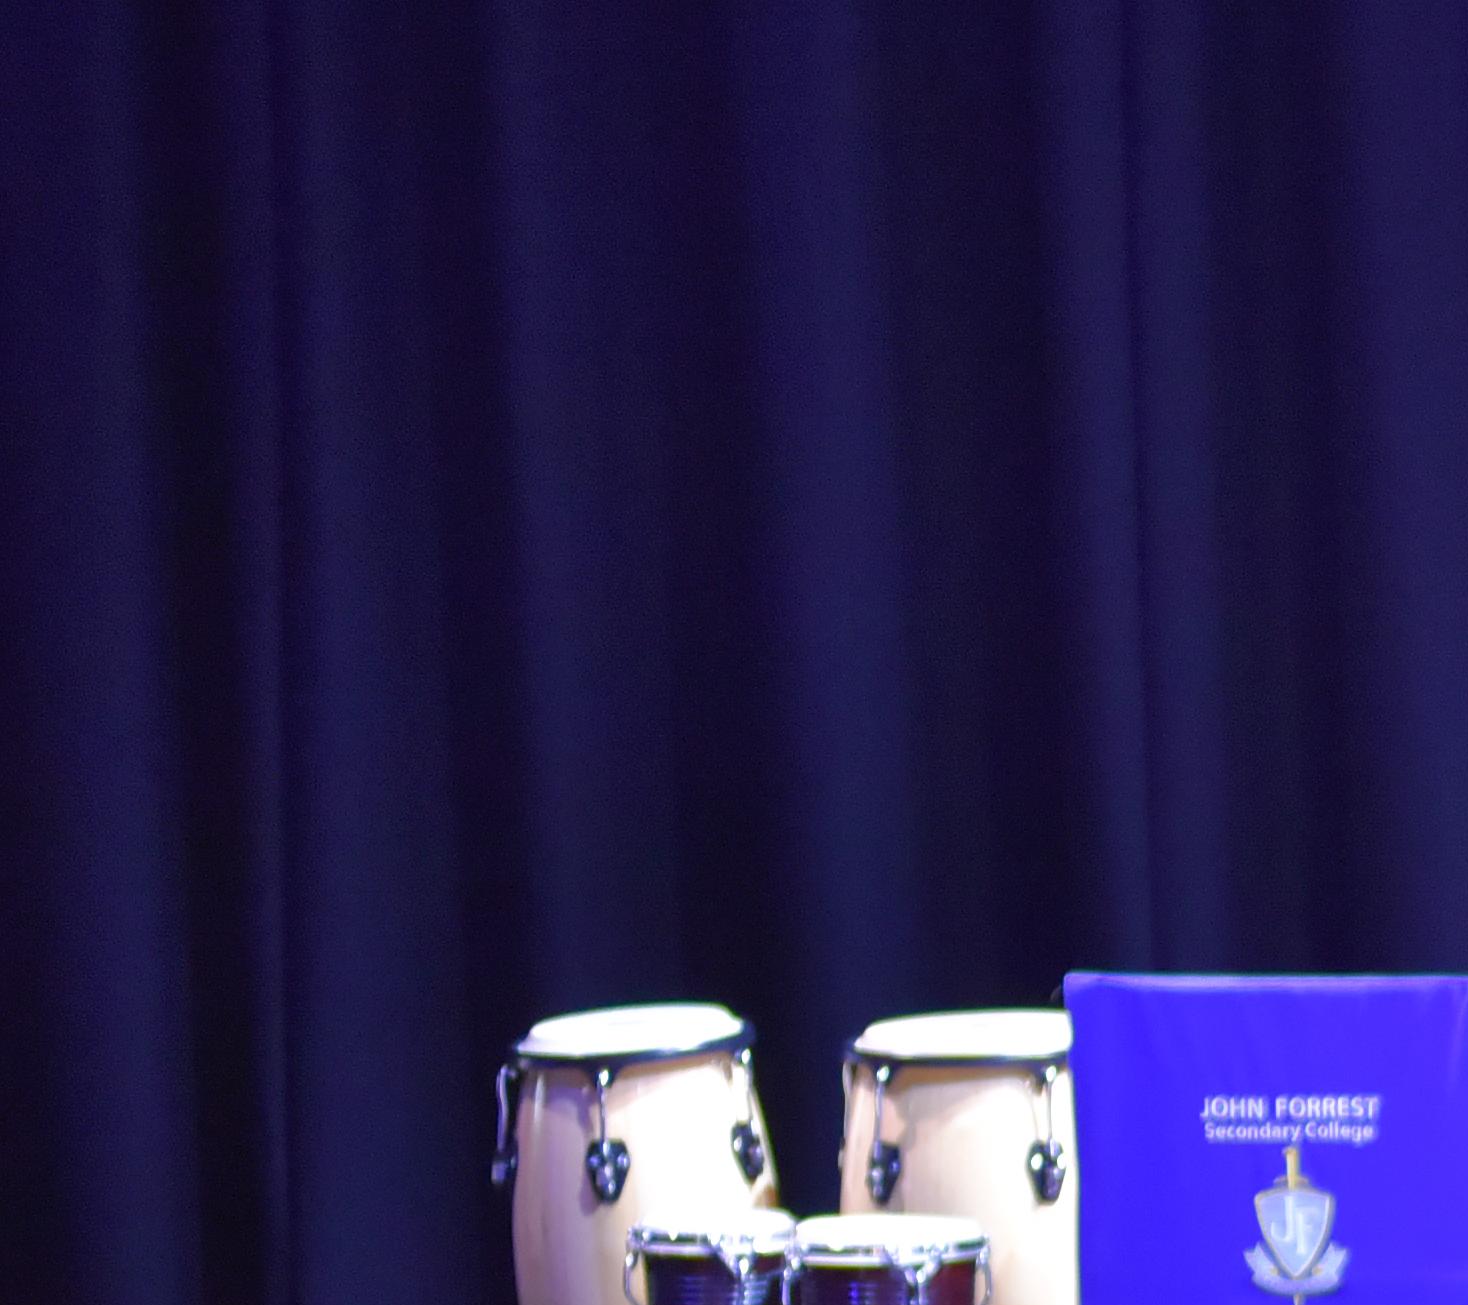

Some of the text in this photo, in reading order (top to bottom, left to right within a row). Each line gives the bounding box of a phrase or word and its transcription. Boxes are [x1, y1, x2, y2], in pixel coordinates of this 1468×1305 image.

[1201, 1096, 1379, 1119] JOHN FORREST
[1204, 1121, 1374, 1143] Secondary College
